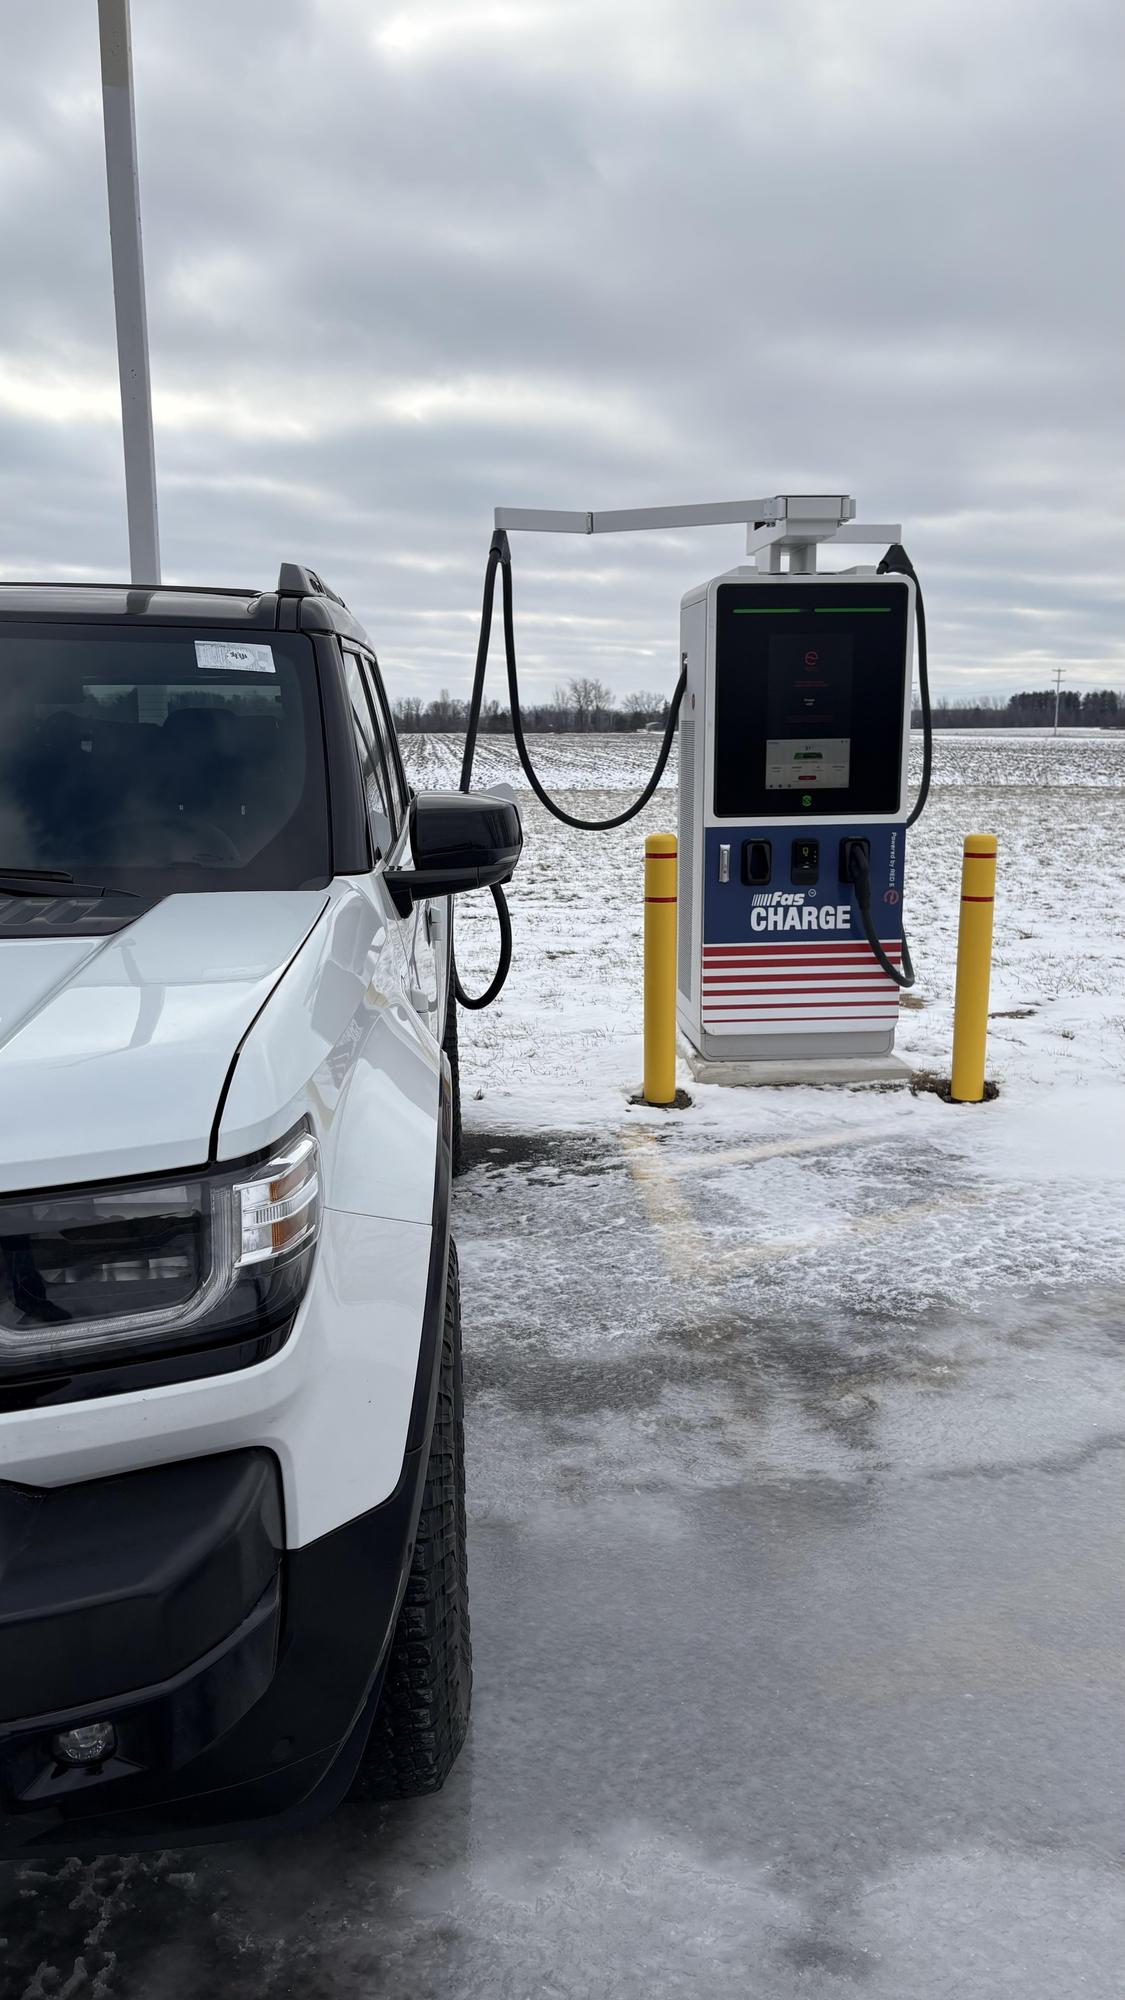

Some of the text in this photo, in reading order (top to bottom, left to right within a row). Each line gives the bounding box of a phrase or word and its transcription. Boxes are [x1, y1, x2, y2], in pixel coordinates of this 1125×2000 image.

[888, 859, 896, 868] by
[771, 892, 805, 906] Fas
[751, 906, 851, 932] CHARGE
